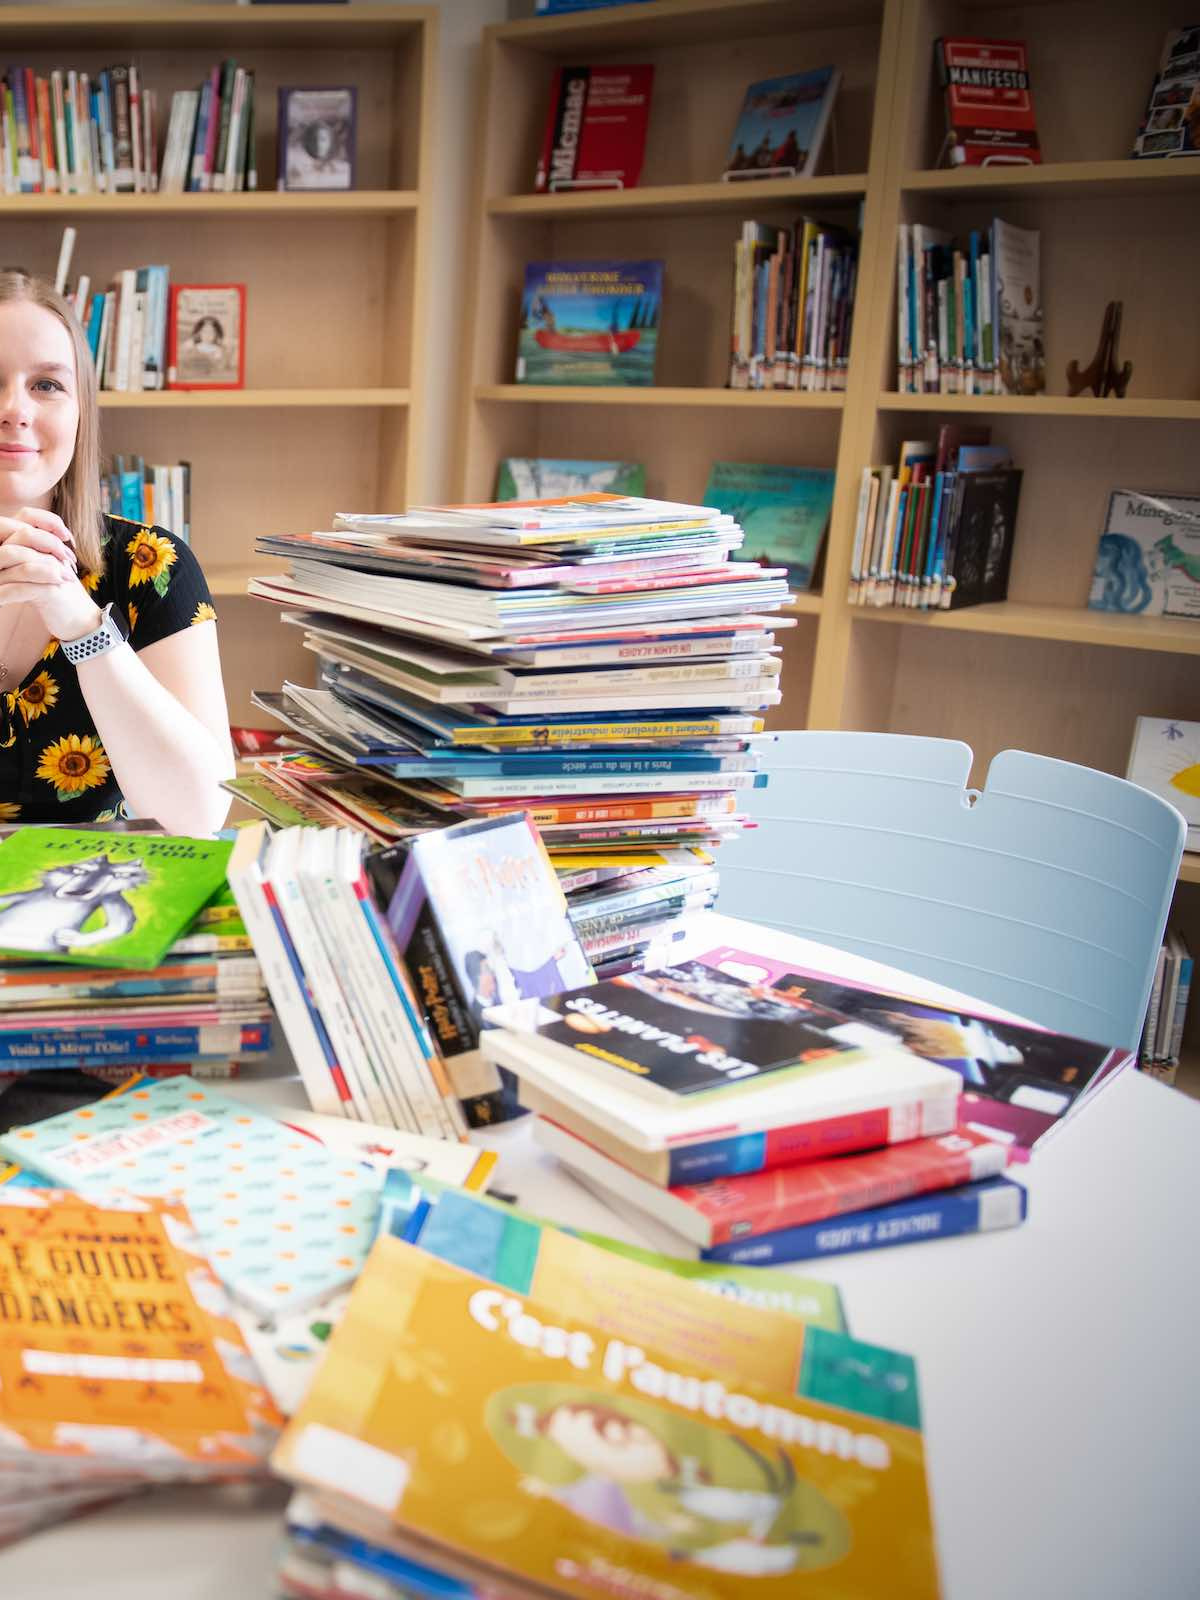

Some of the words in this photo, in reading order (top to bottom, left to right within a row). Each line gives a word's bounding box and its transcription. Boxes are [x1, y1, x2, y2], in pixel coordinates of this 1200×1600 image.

[950, 67, 1026, 89] MANIFESTO
[551, 79, 586, 180] Micmac
[652, 760, 672, 770] Paris
[48, 1247, 176, 1285] GUIDE
[467, 1288, 597, 1370] C'est
[603, 1338, 892, 1471] l'automne
